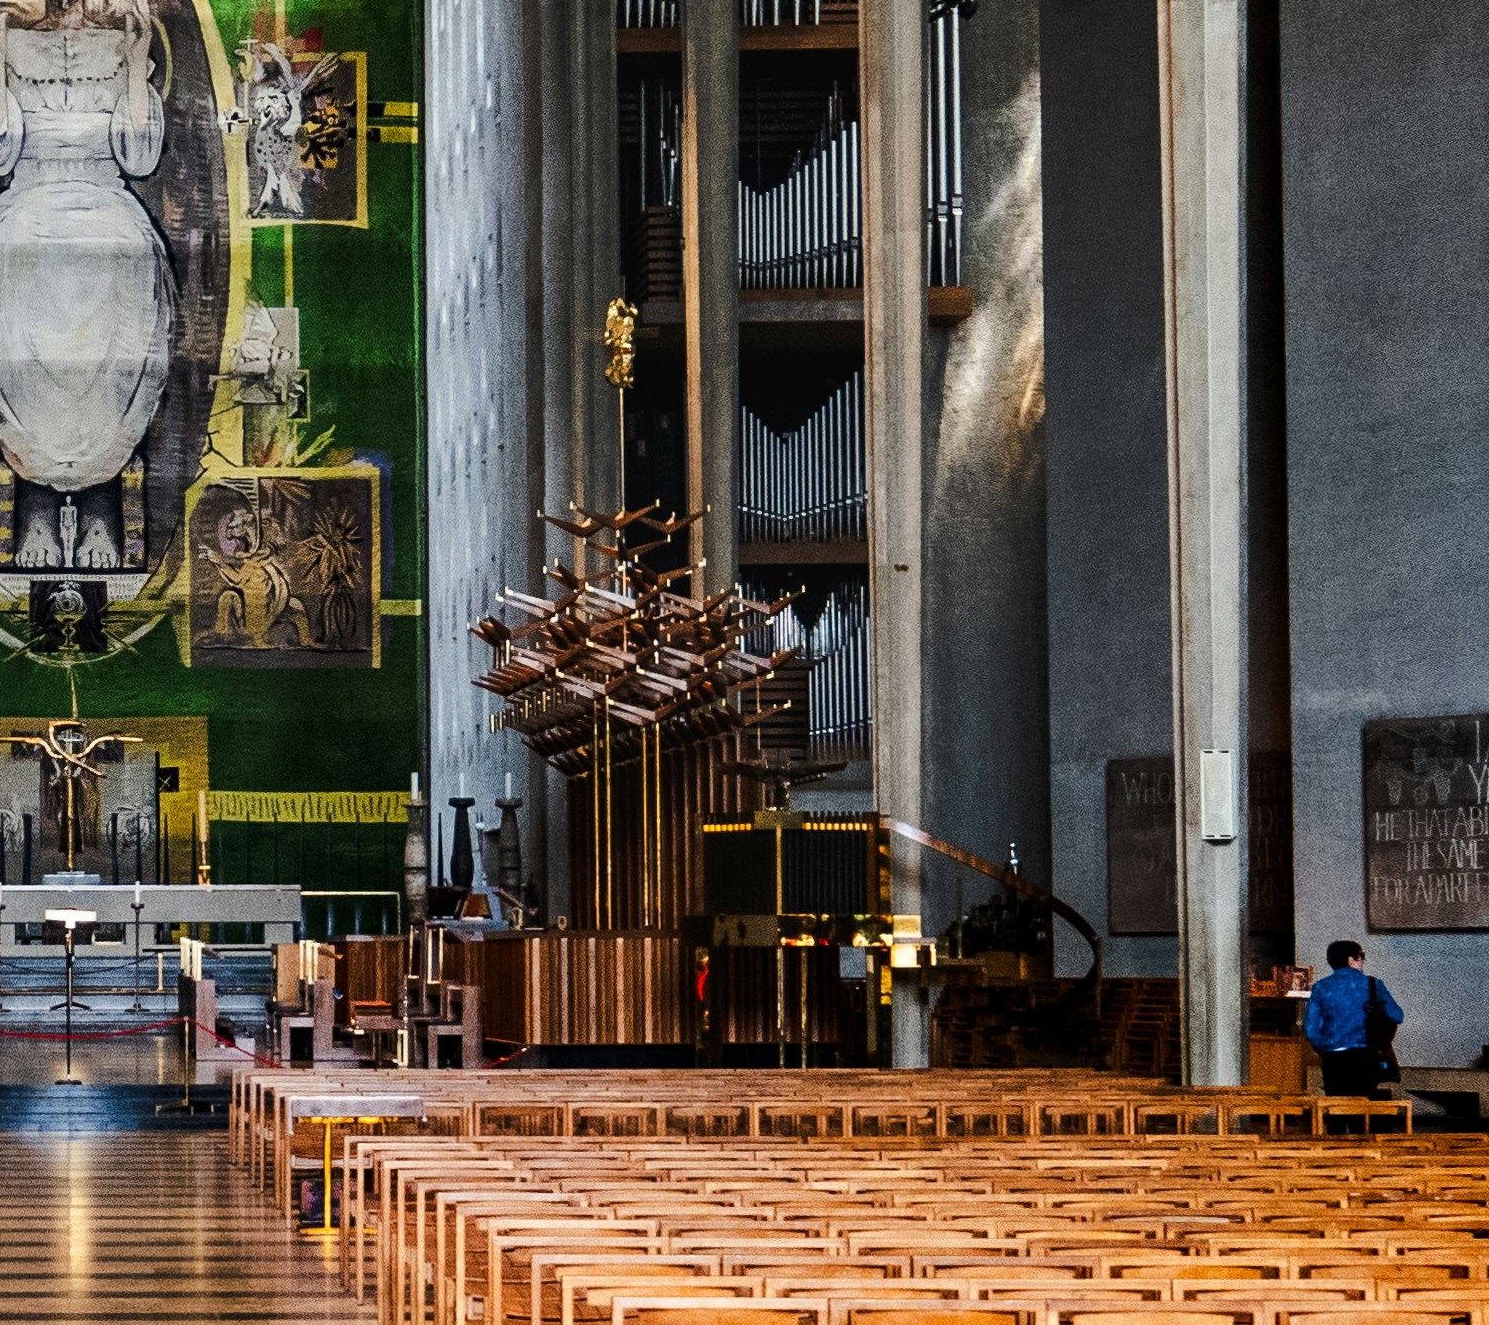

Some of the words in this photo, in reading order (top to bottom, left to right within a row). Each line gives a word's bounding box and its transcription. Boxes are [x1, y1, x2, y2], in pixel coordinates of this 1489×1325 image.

[1374, 810, 1402, 842] HE
[1401, 807, 1454, 840] THAT
[1400, 839, 1435, 872] THE
[1435, 837, 1486, 871] SAME
[1372, 876, 1413, 905] FOR
